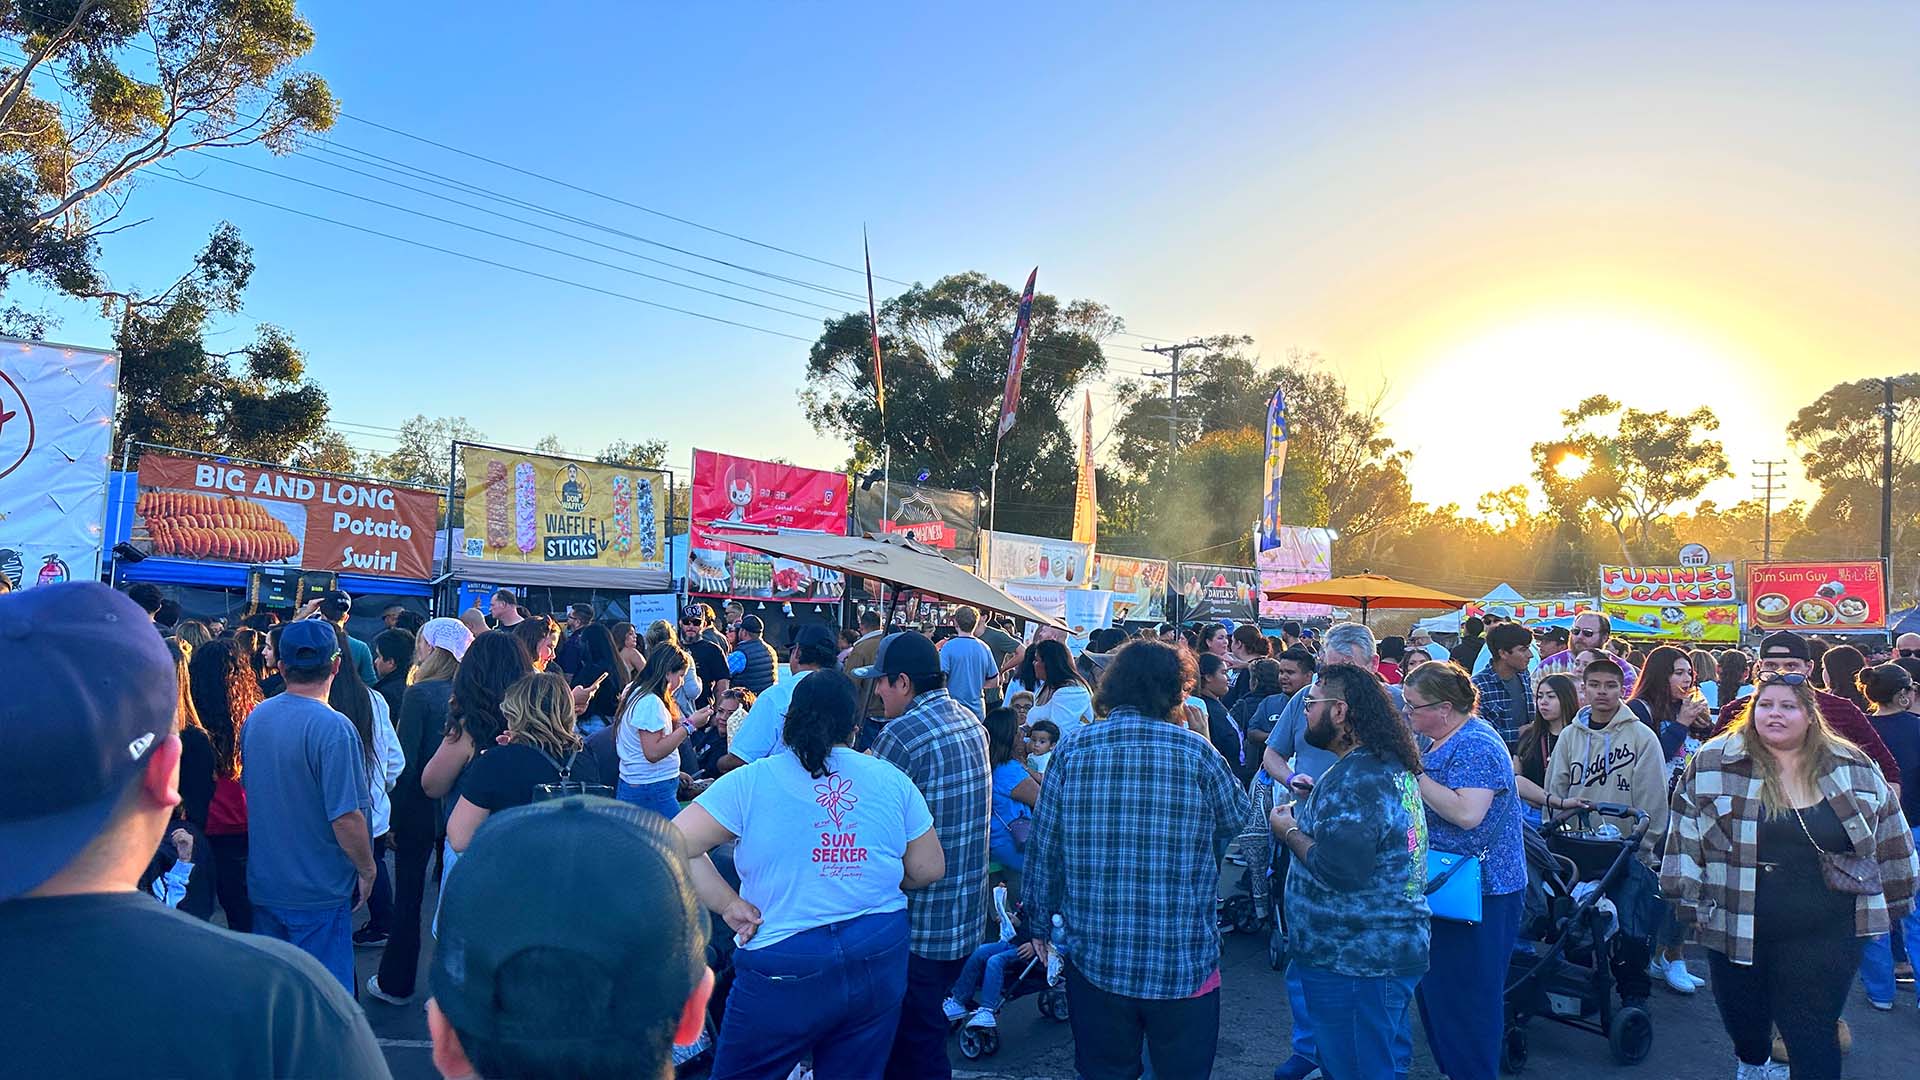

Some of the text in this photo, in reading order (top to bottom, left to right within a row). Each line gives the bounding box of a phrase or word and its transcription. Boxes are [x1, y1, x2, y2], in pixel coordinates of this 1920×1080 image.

[195, 464, 395, 510] BIG AND LONG
[333, 512, 412, 540] Potato
[545, 513, 596, 535] WAFFLE
[547, 538, 596, 557] STICKS
[341, 547, 398, 571] Swirl
[1602, 564, 1734, 584] FUNNEL
[1754, 571, 1828, 583] Dim Sum Guy
[1208, 589, 1234, 600] DAVILA'S
[1631, 581, 1733, 601] CAKES
[1465, 600, 1593, 618] KTTLE
[1569, 744, 1634, 787] Dodgers
[1616, 774, 1630, 791] LA
[821, 832, 856, 847] SUN
[812, 848, 867, 862] SEEKER
